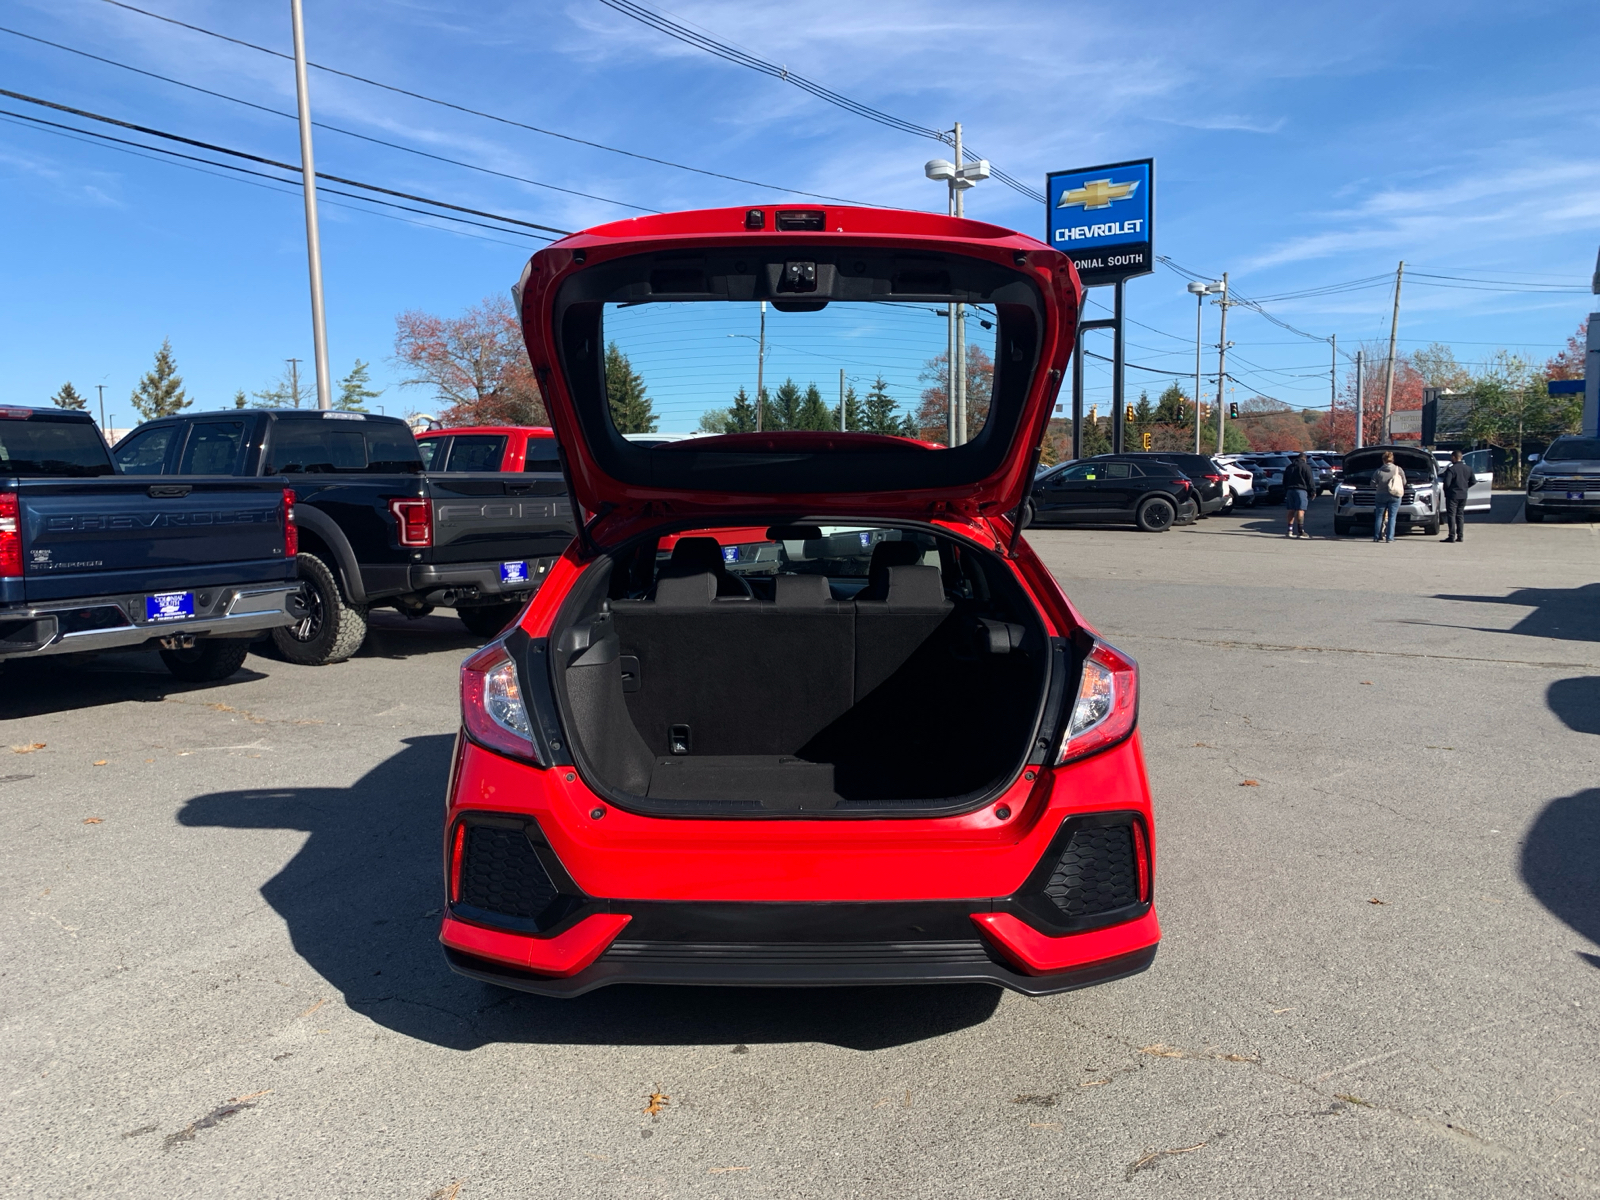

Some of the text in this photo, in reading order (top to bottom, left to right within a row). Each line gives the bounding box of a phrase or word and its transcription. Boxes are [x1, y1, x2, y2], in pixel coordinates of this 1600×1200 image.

[1055, 219, 1143, 242] CHEVROLET
[1075, 254, 1143, 270] ONIAL SOUTH
[47, 510, 275, 531] CHEVROLET
